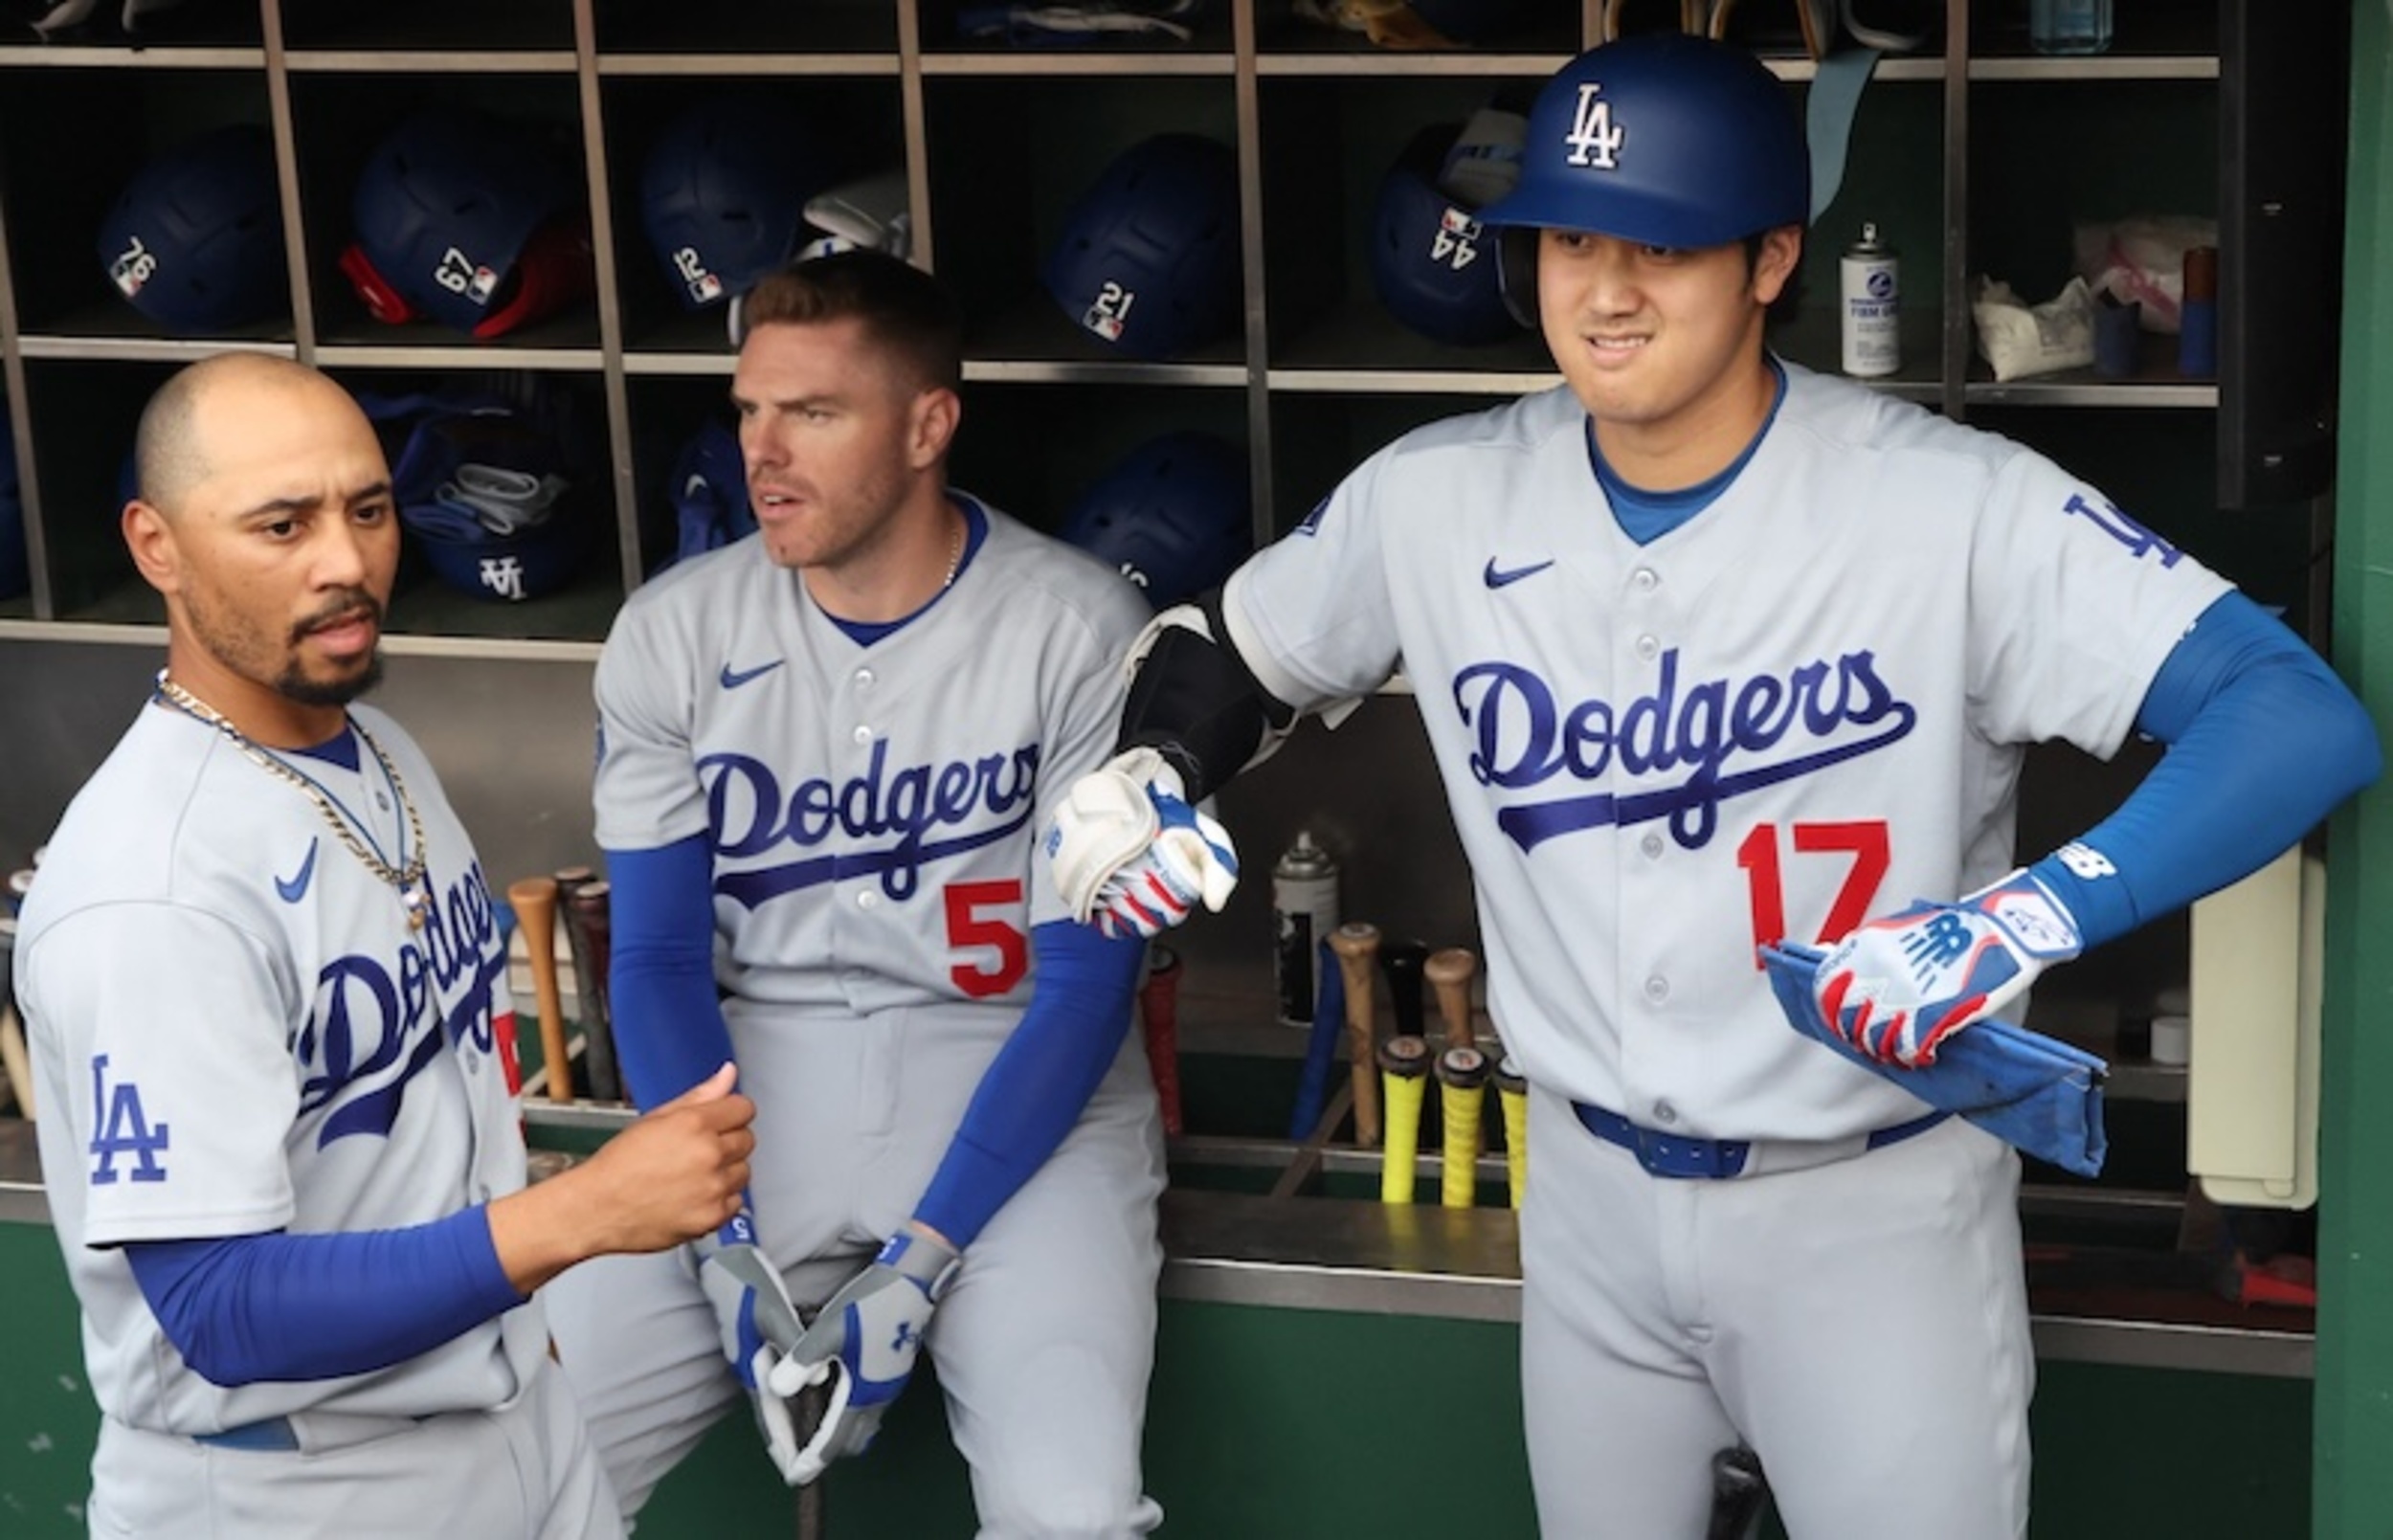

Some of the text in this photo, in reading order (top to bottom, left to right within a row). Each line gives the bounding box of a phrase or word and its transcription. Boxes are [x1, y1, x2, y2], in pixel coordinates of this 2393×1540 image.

[1565, 82, 1623, 168] LA
[119, 235, 157, 282] 76
[435, 247, 474, 292] 67
[673, 247, 707, 281] 12
[1431, 228, 1478, 270] 44
[1097, 281, 1134, 321] 21
[1452, 647, 1917, 852] Dodgers
[696, 736, 1039, 905] Dodgers
[1736, 819, 1891, 972] 17
[943, 878, 1031, 1000] 5
[89, 1053, 169, 1186] LA
[732, 1216, 749, 1239] 5
